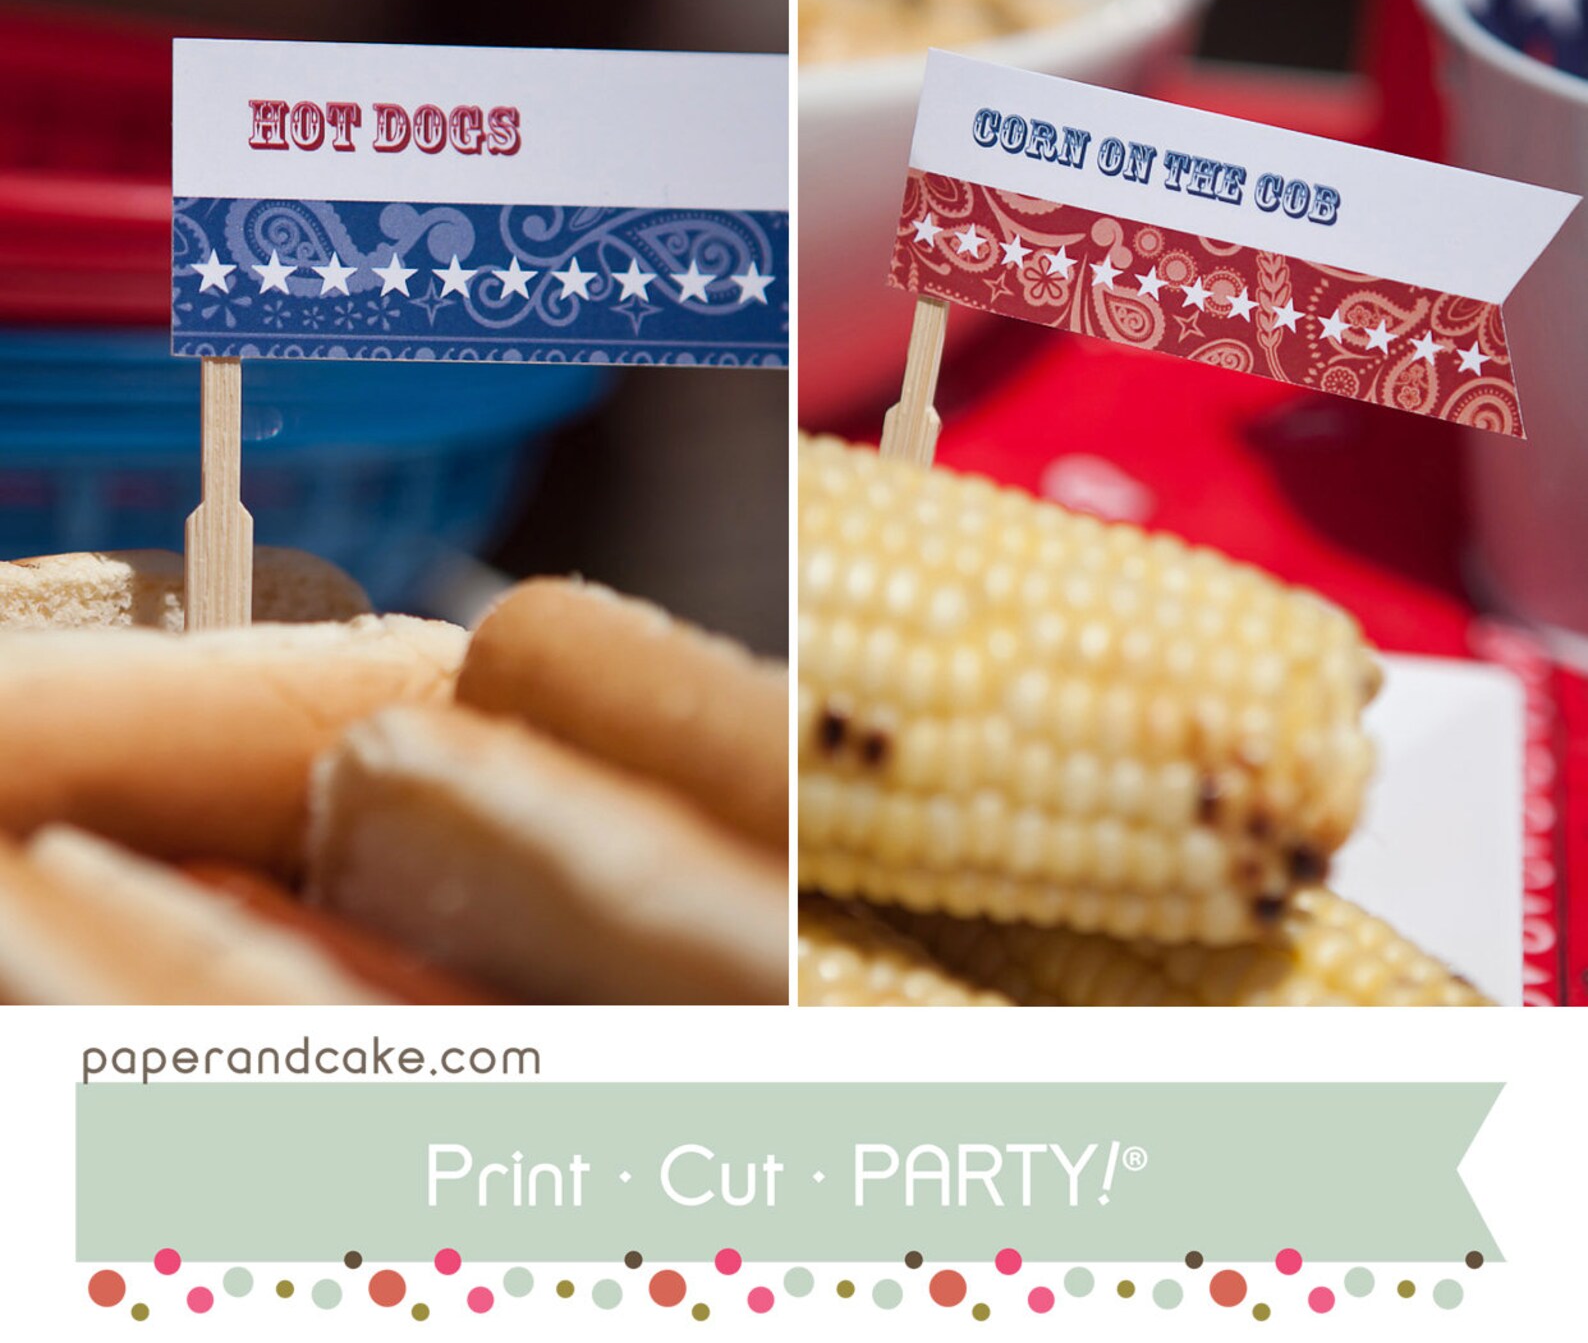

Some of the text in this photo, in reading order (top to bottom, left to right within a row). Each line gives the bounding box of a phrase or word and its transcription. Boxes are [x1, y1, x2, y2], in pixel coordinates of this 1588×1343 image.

[248, 99, 521, 155] HOT DOGS
[972, 107, 1341, 226] CORN ON THE COB
